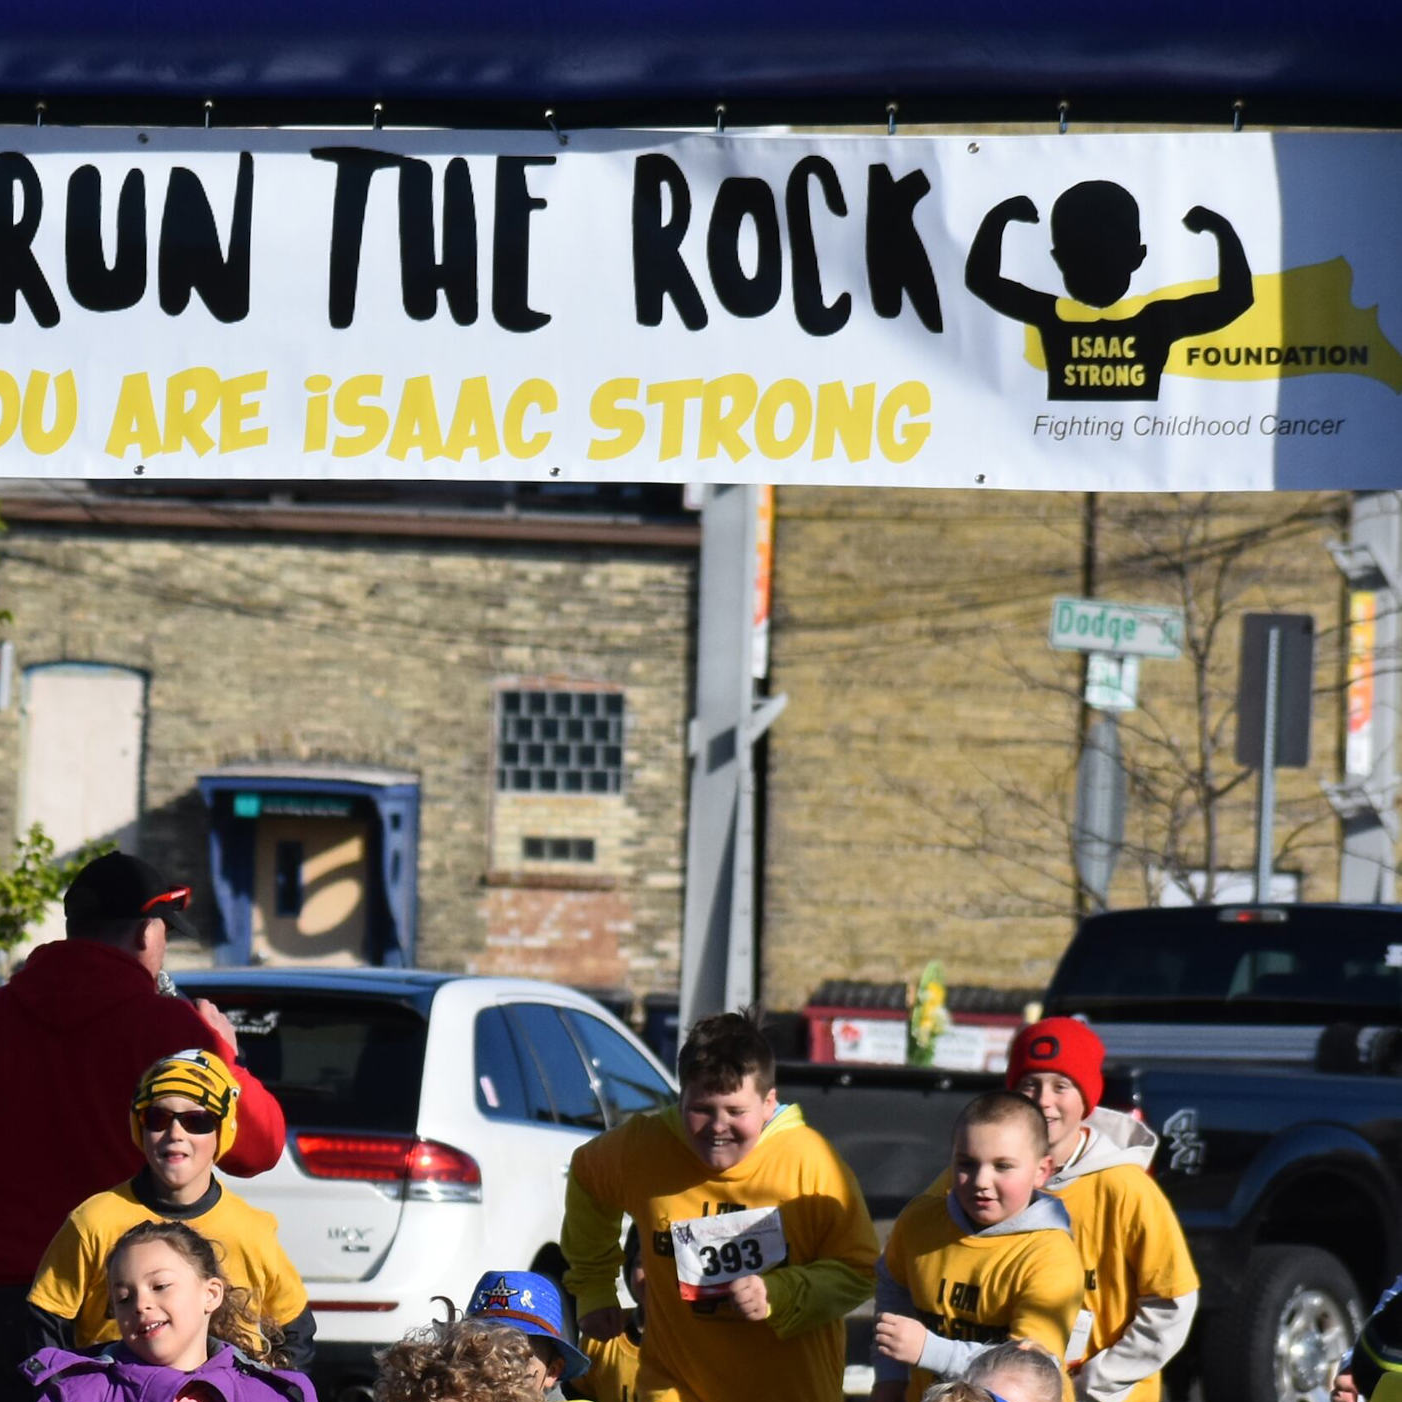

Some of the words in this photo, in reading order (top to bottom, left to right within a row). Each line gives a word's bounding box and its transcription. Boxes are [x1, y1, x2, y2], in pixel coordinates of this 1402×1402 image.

[311, 146, 557, 333] THE
[633, 153, 944, 337] ROCK
[1070, 335, 1137, 359] ISAAC
[1186, 345, 1369, 368] FOUNDATION
[1063, 362, 1146, 388] STRONG
[104, 366, 269, 460] ARE
[588, 373, 931, 464] STRONG
[1033, 415, 1125, 441] Fighting
[1133, 414, 1251, 438] Childhood
[1266, 415, 1345, 437] Cancer
[1057, 602, 1136, 647] Dodge
[699, 1238, 764, 1277] 393
